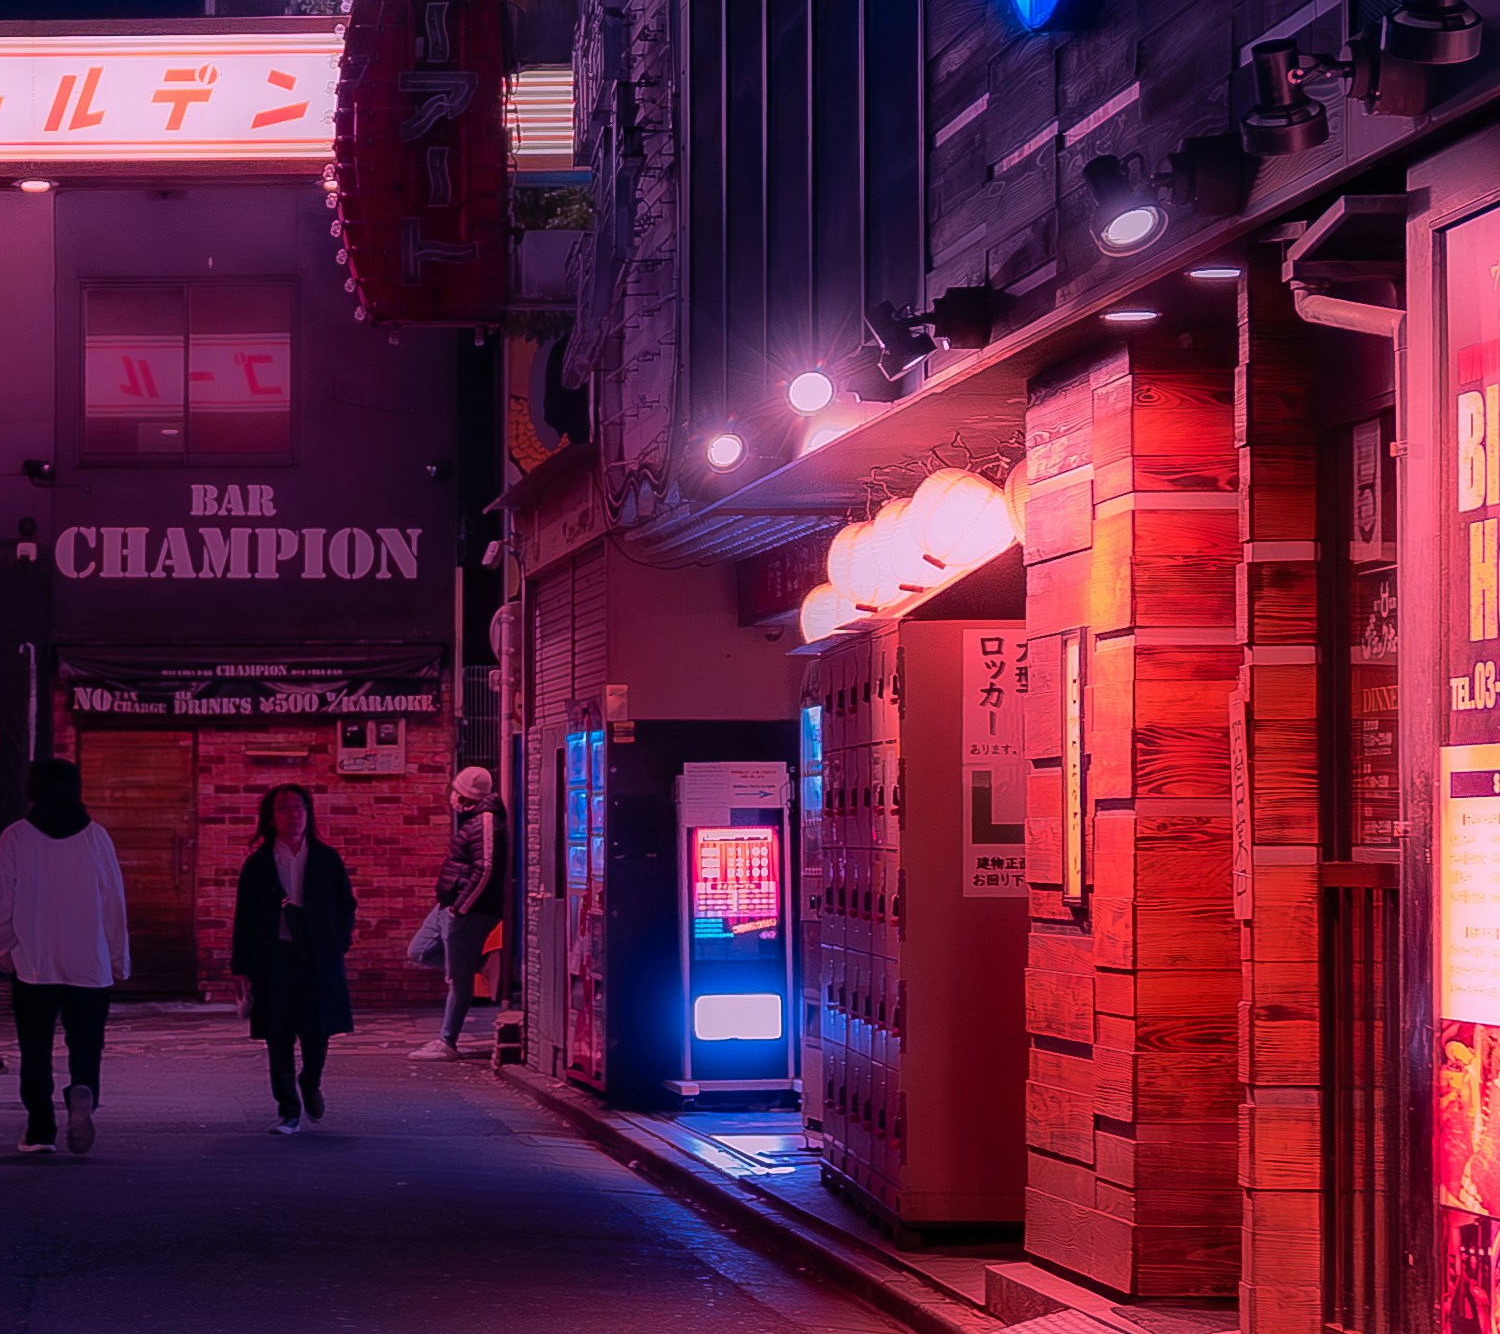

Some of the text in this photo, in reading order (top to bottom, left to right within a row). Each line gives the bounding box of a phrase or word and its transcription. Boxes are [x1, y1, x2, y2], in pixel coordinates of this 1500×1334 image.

[190, 483, 277, 517] BAR
[55, 525, 423, 580] CHAMPION
[215, 662, 289, 678] CHAMPION
[73, 687, 112, 712] NO
[979, 636, 1006, 737] ロッカー
[113, 700, 167, 714] CHARGE
